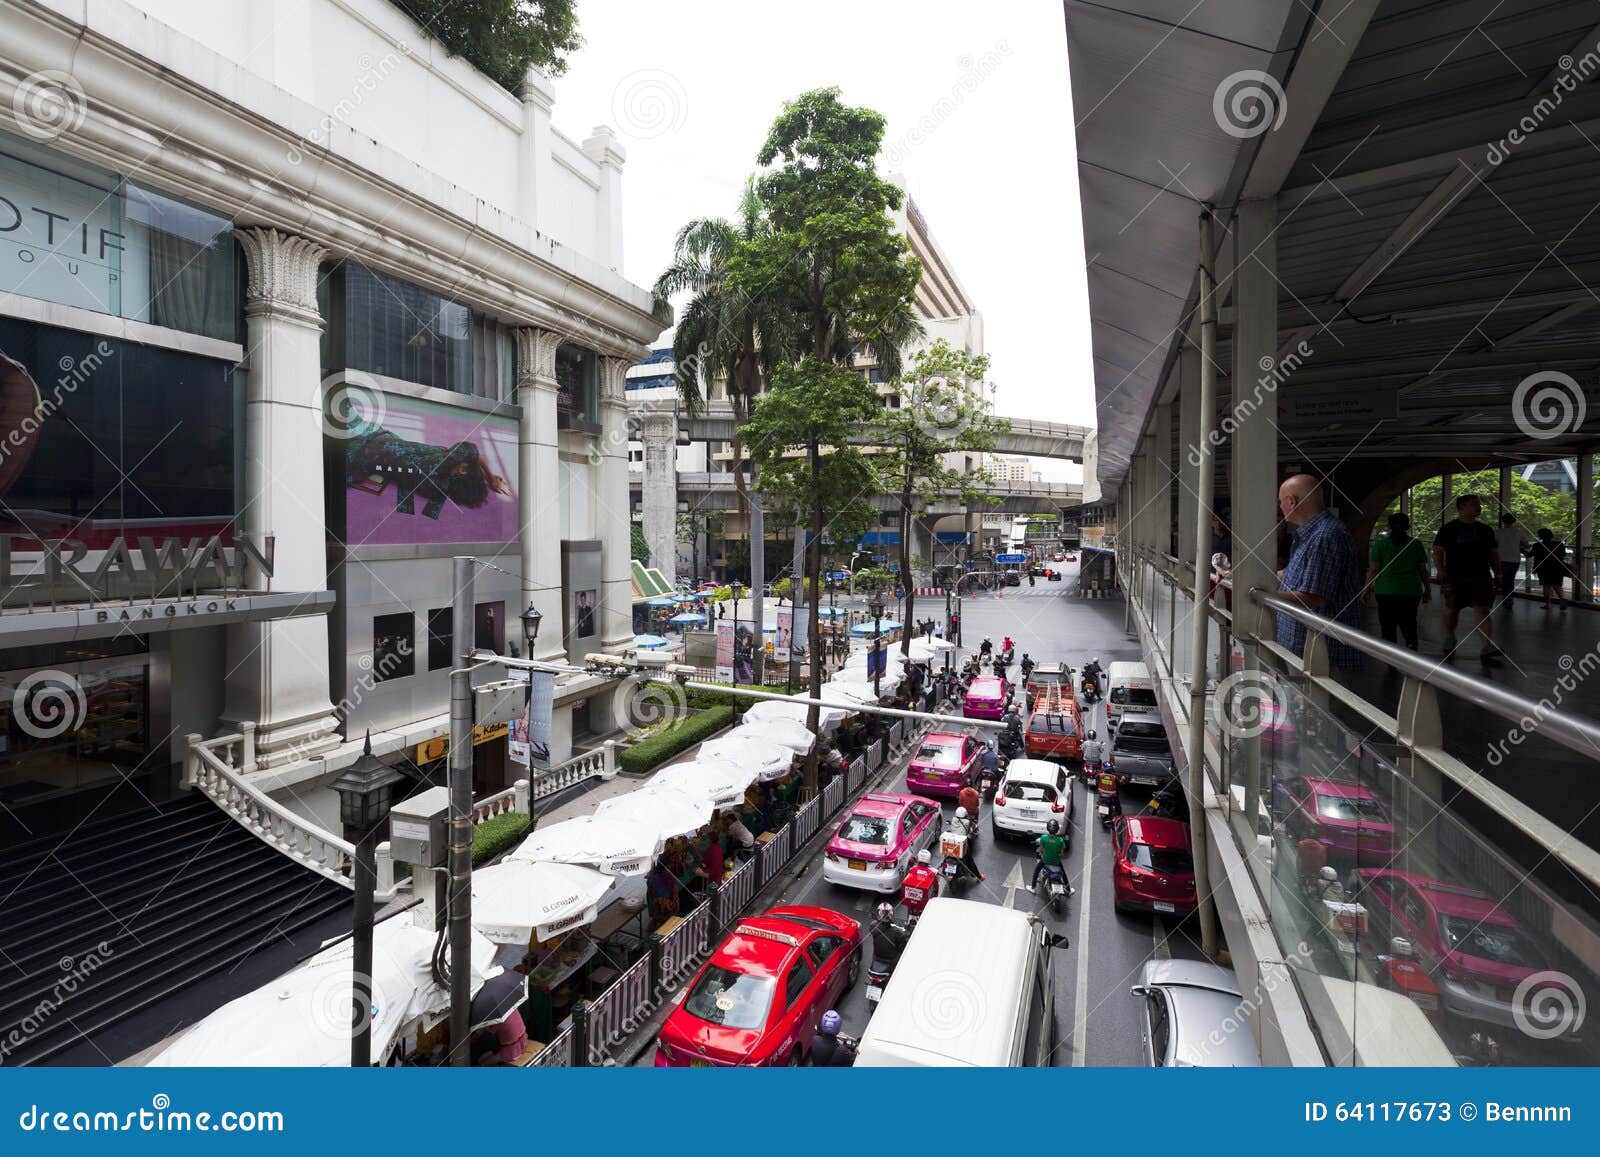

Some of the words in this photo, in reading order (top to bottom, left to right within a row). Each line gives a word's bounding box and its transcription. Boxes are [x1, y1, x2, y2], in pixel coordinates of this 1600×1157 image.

[0, 530, 275, 592] ERAWAN
[96, 600, 237, 624] BANGKOK
[548, 912, 584, 933] B.GRIMM
